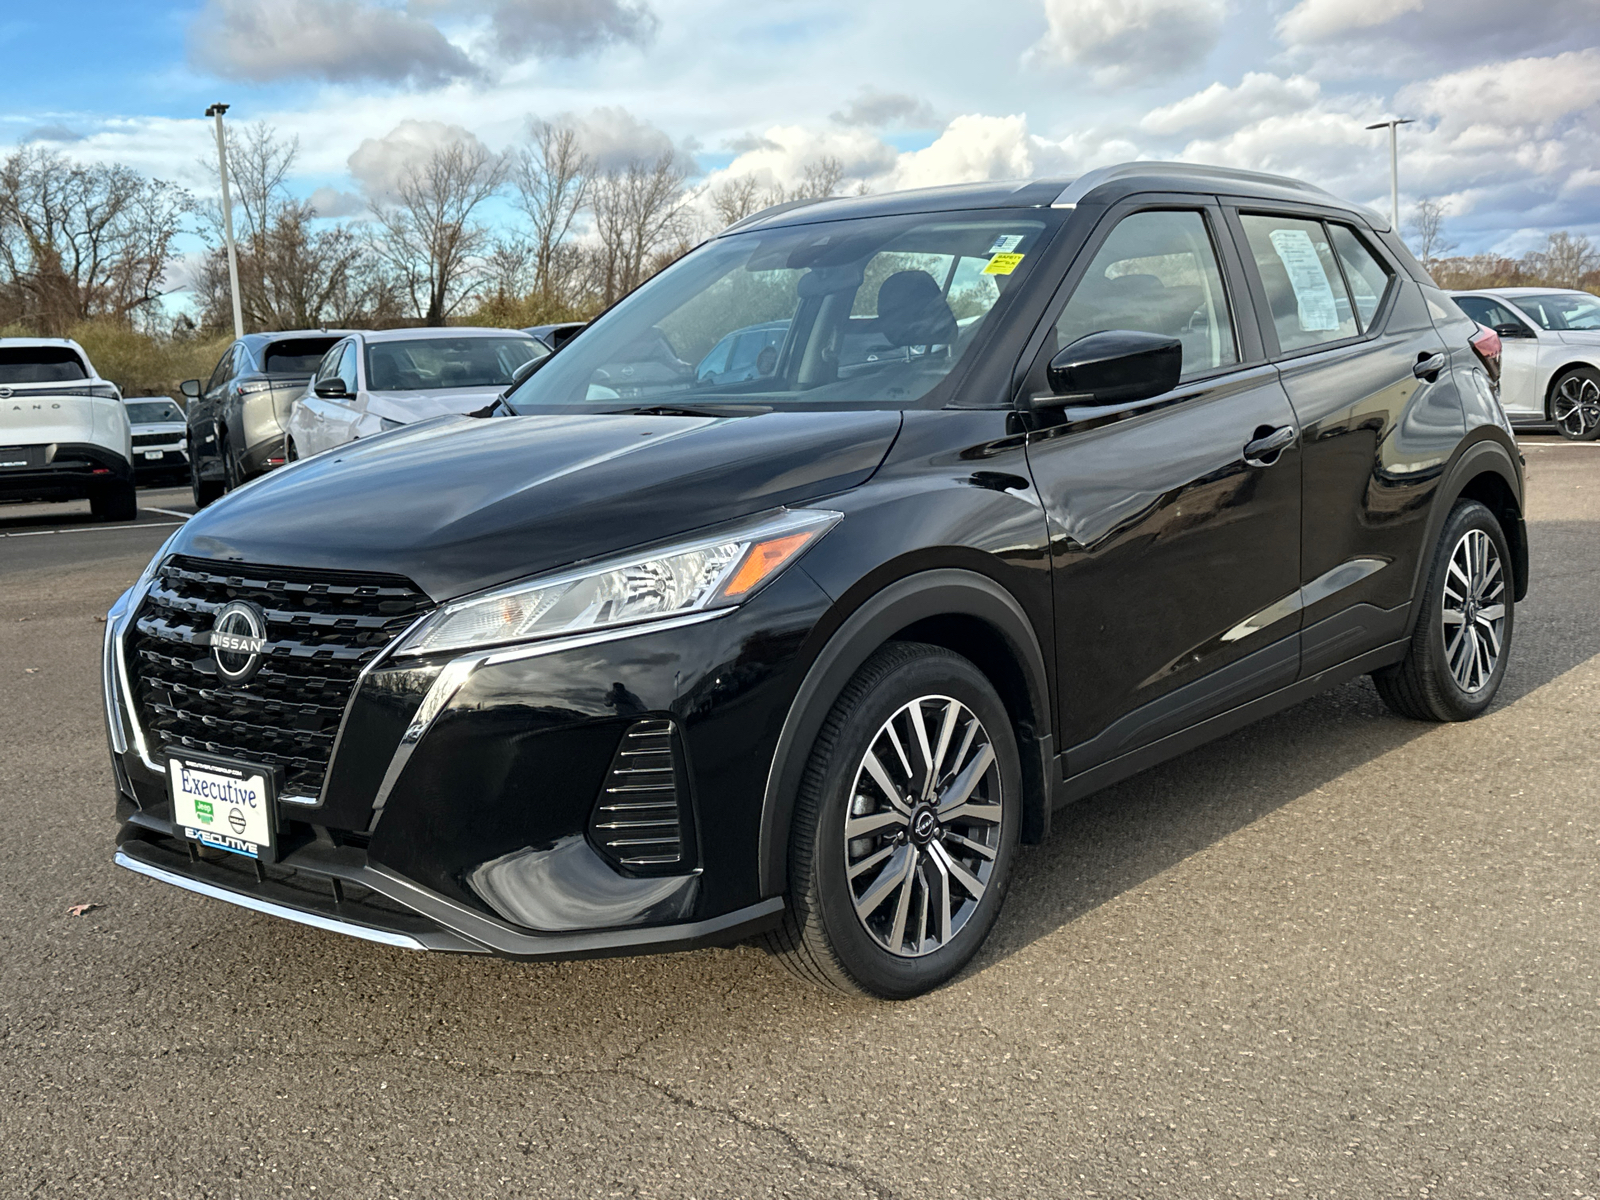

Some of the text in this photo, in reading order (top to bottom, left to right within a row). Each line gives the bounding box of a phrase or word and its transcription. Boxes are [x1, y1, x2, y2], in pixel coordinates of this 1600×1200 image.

[210, 633, 261, 653] NISSAN
[180, 767, 257, 809] Executive
[197, 801, 212, 814] Jeep
[184, 827, 258, 854] EXECUTIVE
